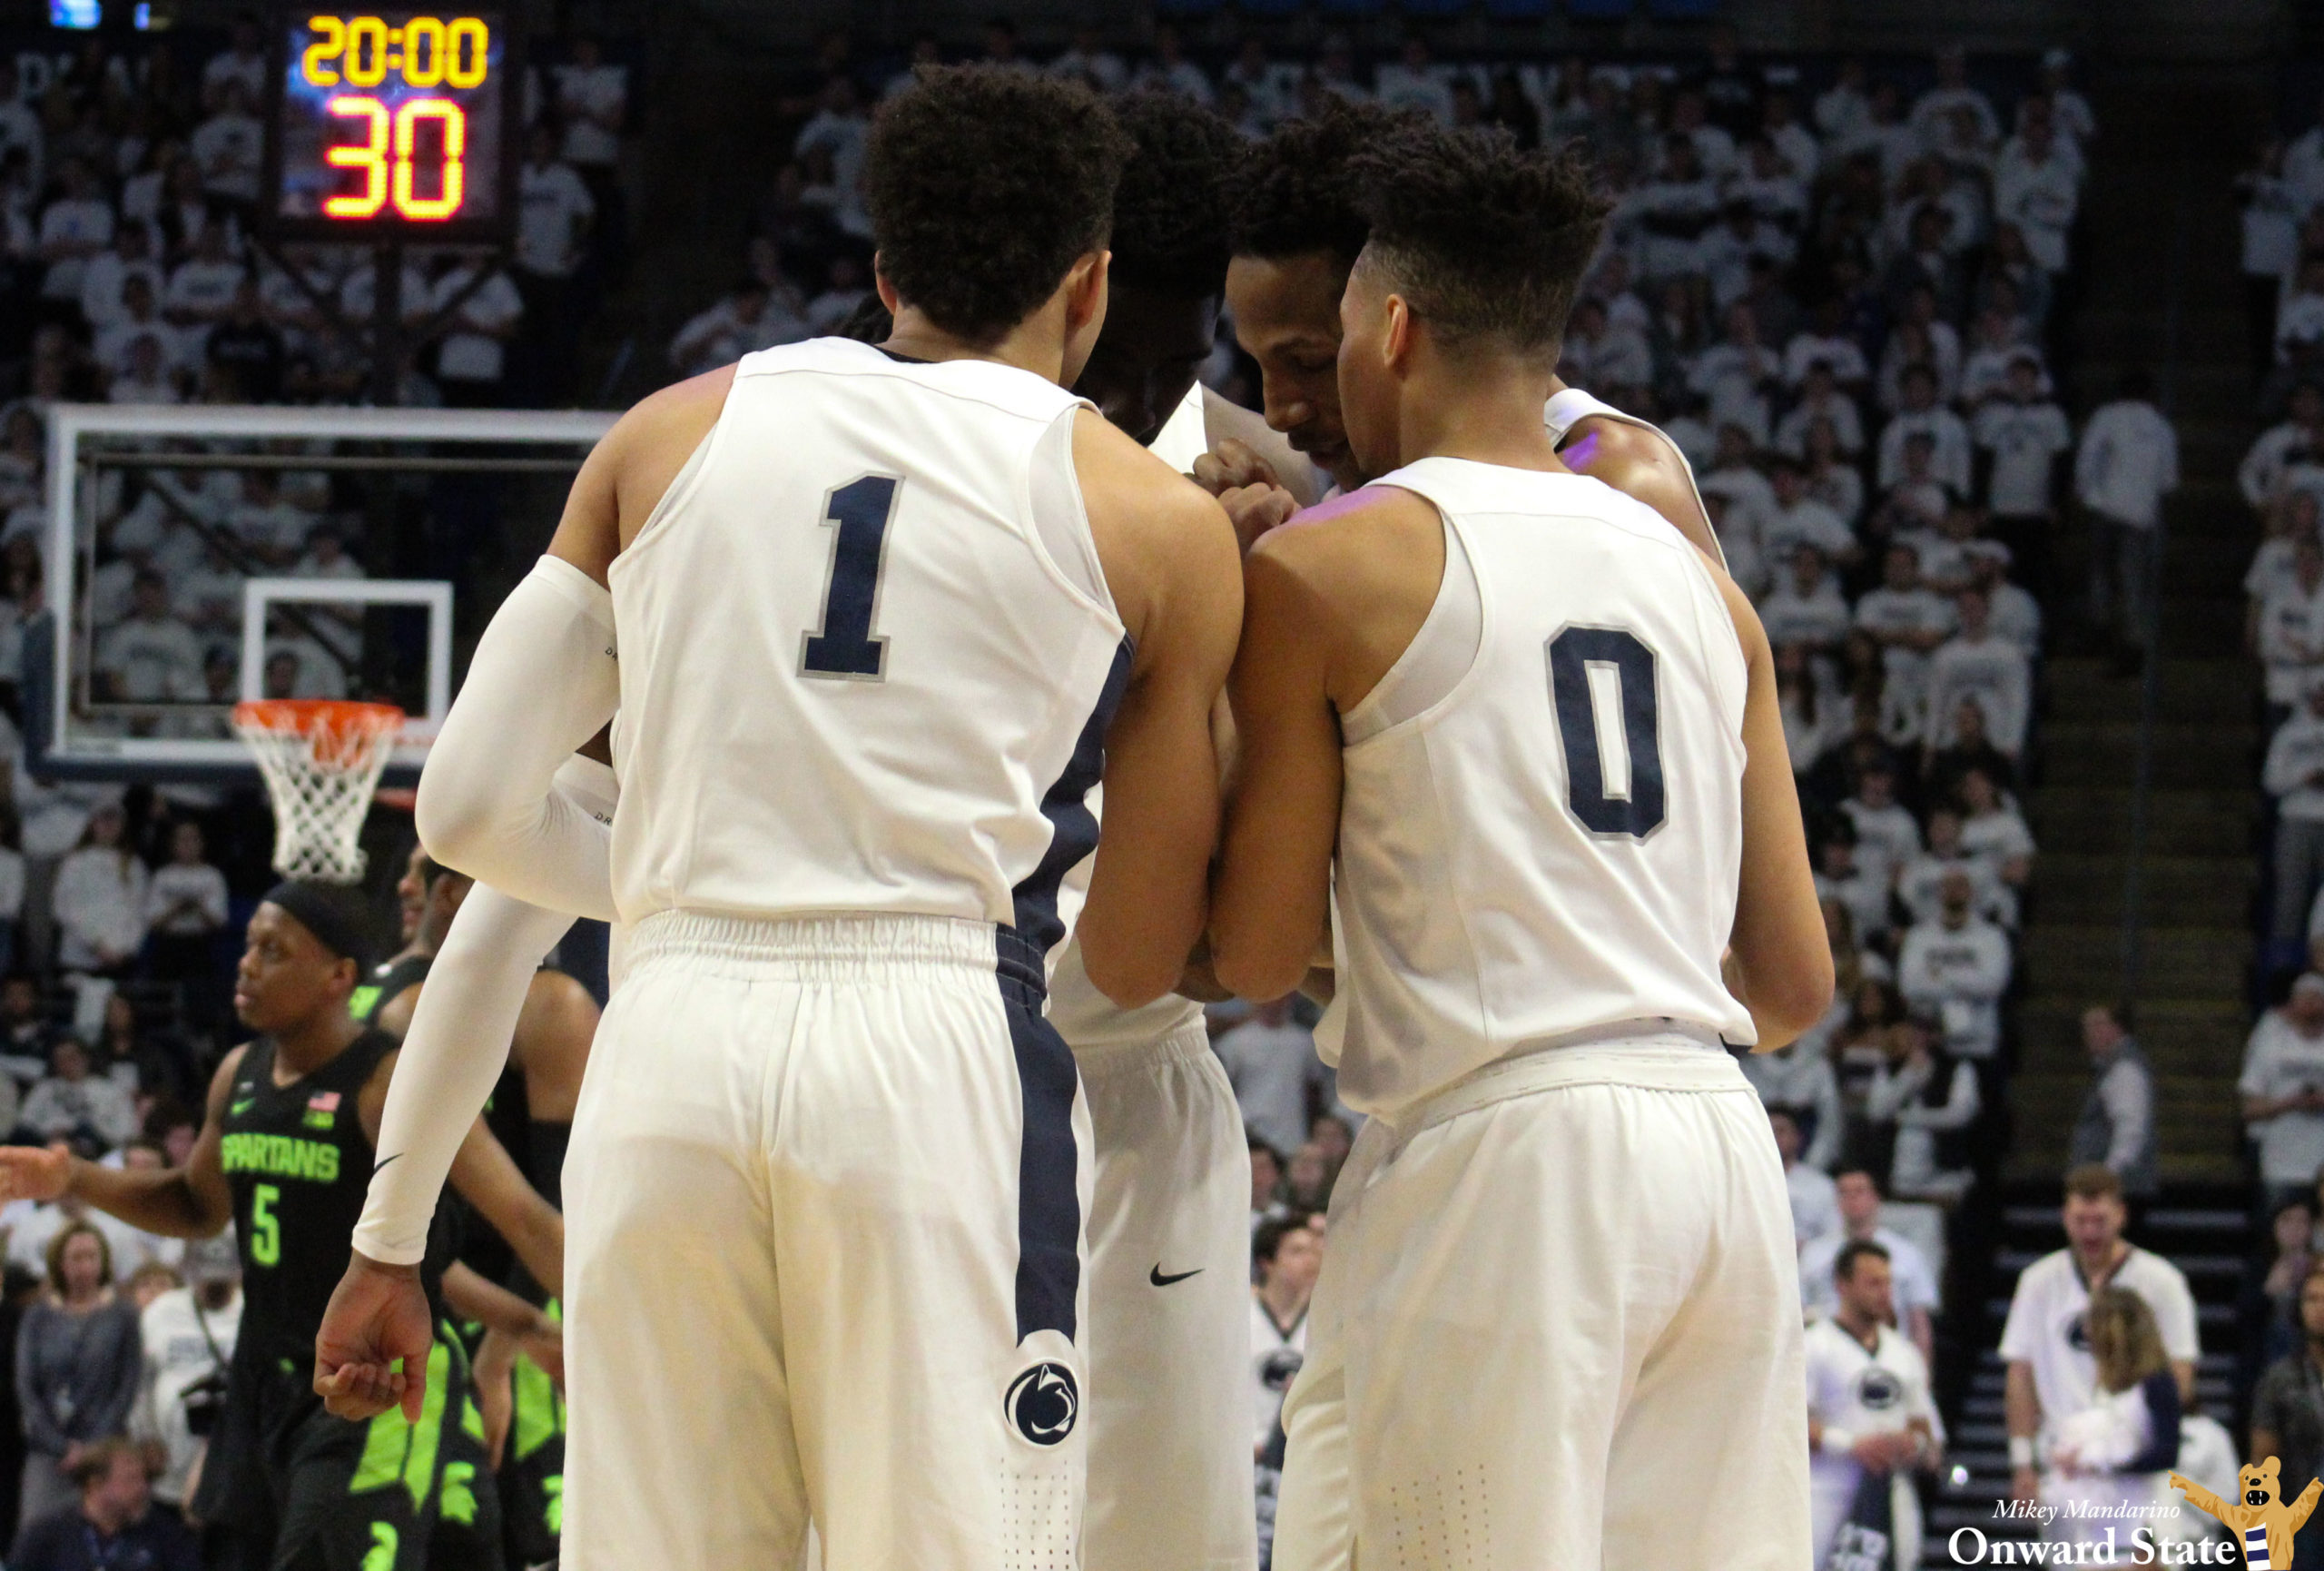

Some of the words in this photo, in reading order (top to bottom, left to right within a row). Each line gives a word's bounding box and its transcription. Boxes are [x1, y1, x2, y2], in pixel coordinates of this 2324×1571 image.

[302, 15, 488, 88] 20:00
[322, 94, 467, 221] 30
[796, 470, 906, 683] 1
[1542, 619, 1669, 846] 0
[222, 1132, 340, 1183] SPARTANS
[251, 1183, 281, 1266] 5
